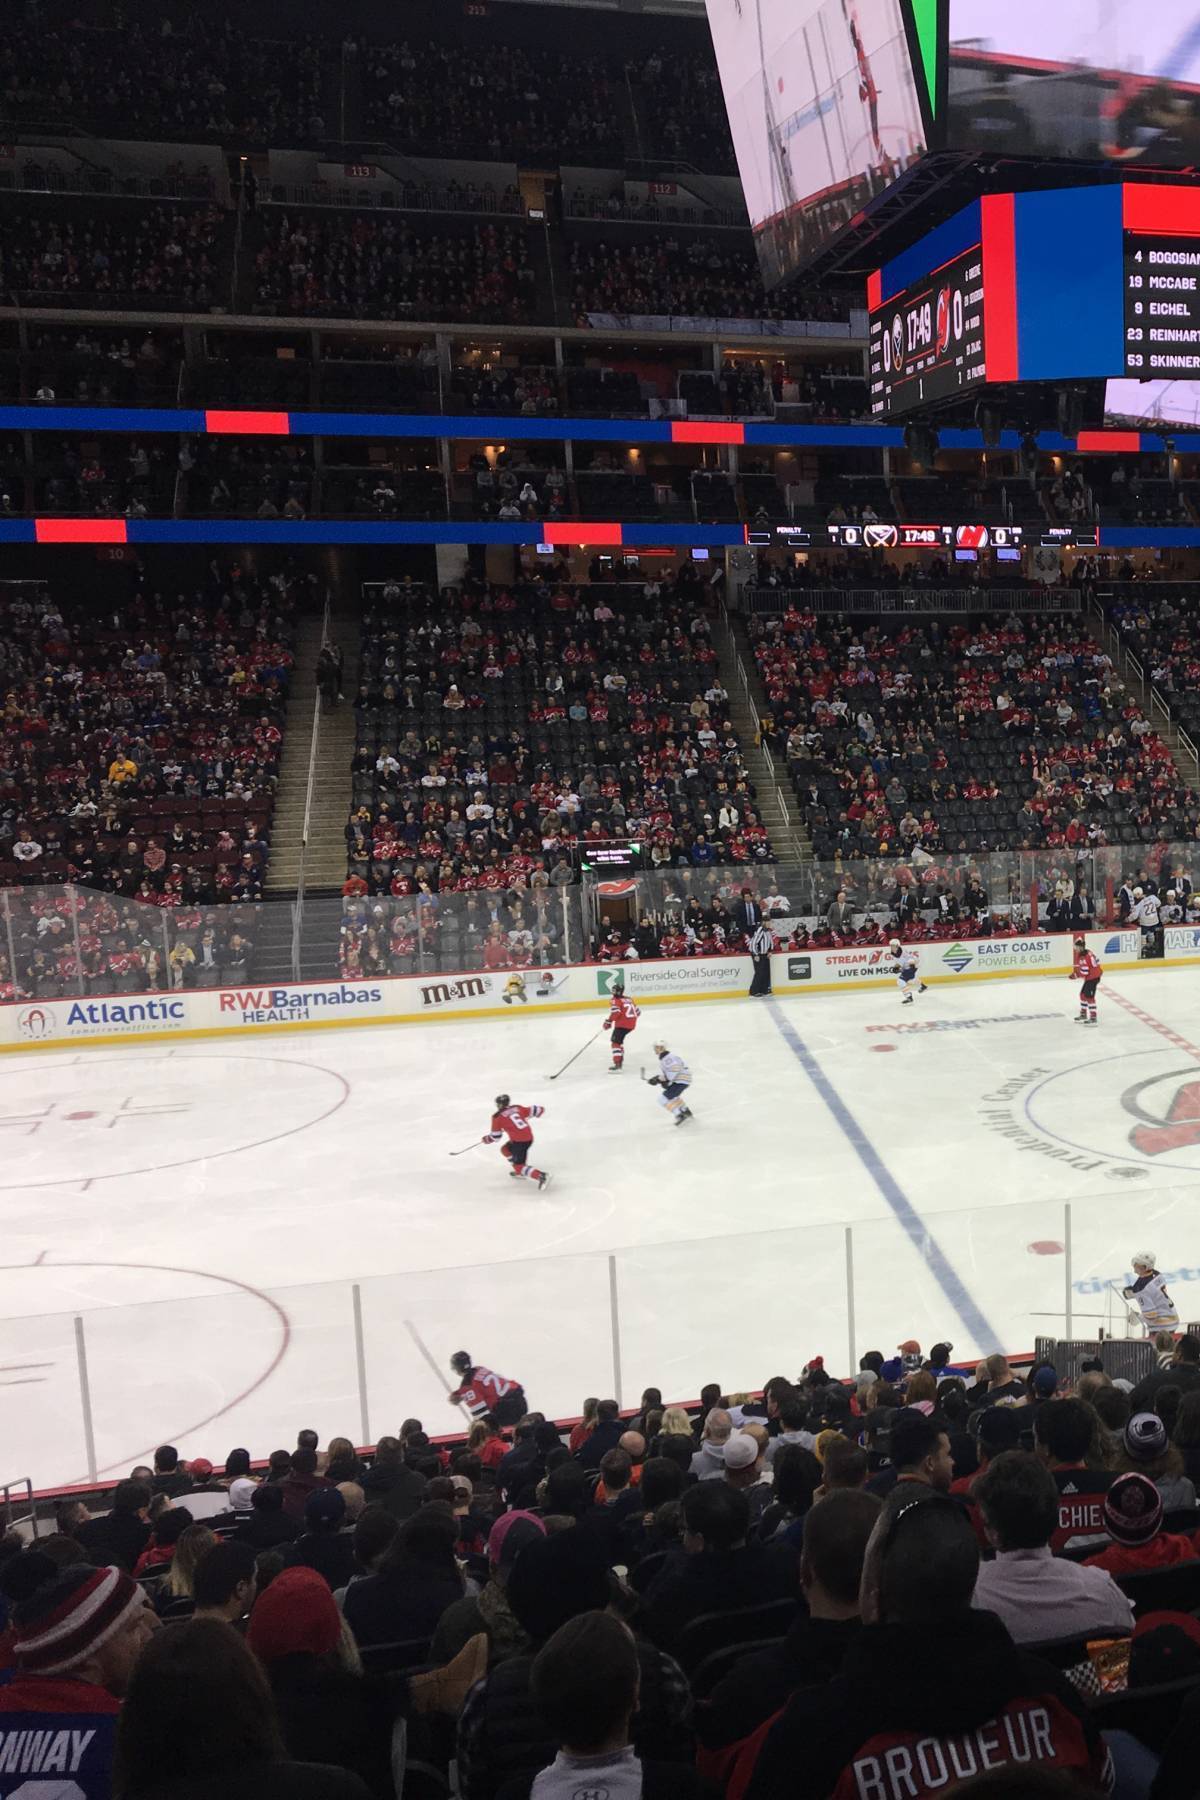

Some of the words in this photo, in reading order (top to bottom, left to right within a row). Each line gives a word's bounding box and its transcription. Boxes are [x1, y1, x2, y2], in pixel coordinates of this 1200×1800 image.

[352, 166, 370, 177] 113
[654, 183, 672, 194] 112
[1134, 251, 1142, 263] 4
[1130, 276, 1143, 288] 19
[1150, 276, 1196, 290] MCCABE
[953, 289, 963, 340] 0
[1134, 302, 1143, 314] 9
[1150, 302, 1191, 316] EICHEL
[906, 302, 932, 352] 17:49
[1127, 328, 1144, 341] 23
[883, 329, 891, 372] 0
[1127, 354, 1144, 367] 53
[1150, 355, 1200, 368] SKINNER
[846, 529, 858, 544] 0
[904, 529, 936, 542] 17:49
[996, 529, 1006, 544] 0
[108, 548, 124, 560] 10
[1144, 904, 1158, 916] 22
[978, 944, 1008, 955] EAST
[1012, 940, 1050, 952] COAST
[1121, 930, 1195, 952] HMAR
[825, 955, 866, 966] STREAM
[978, 956, 1013, 966] POWER
[1016, 955, 1026, 965] &
[1028, 953, 1052, 964] GAS
[630, 970, 676, 982] Riverside
[678, 968, 700, 979] Oral
[700, 967, 741, 980] Surgery
[838, 969, 859, 978] LIVE
[220, 984, 382, 1012] RWJBarnabas
[67, 998, 185, 1026] Atlantic
[243, 1008, 310, 1023] HEALTH
[981, 1067, 1051, 1102] Center
[510, 1114, 527, 1130] 6
[978, 1108, 1108, 1172] Prudential
[1058, 1504, 1105, 1528] CHIE
[0, 1730, 96, 1773] NWAY
